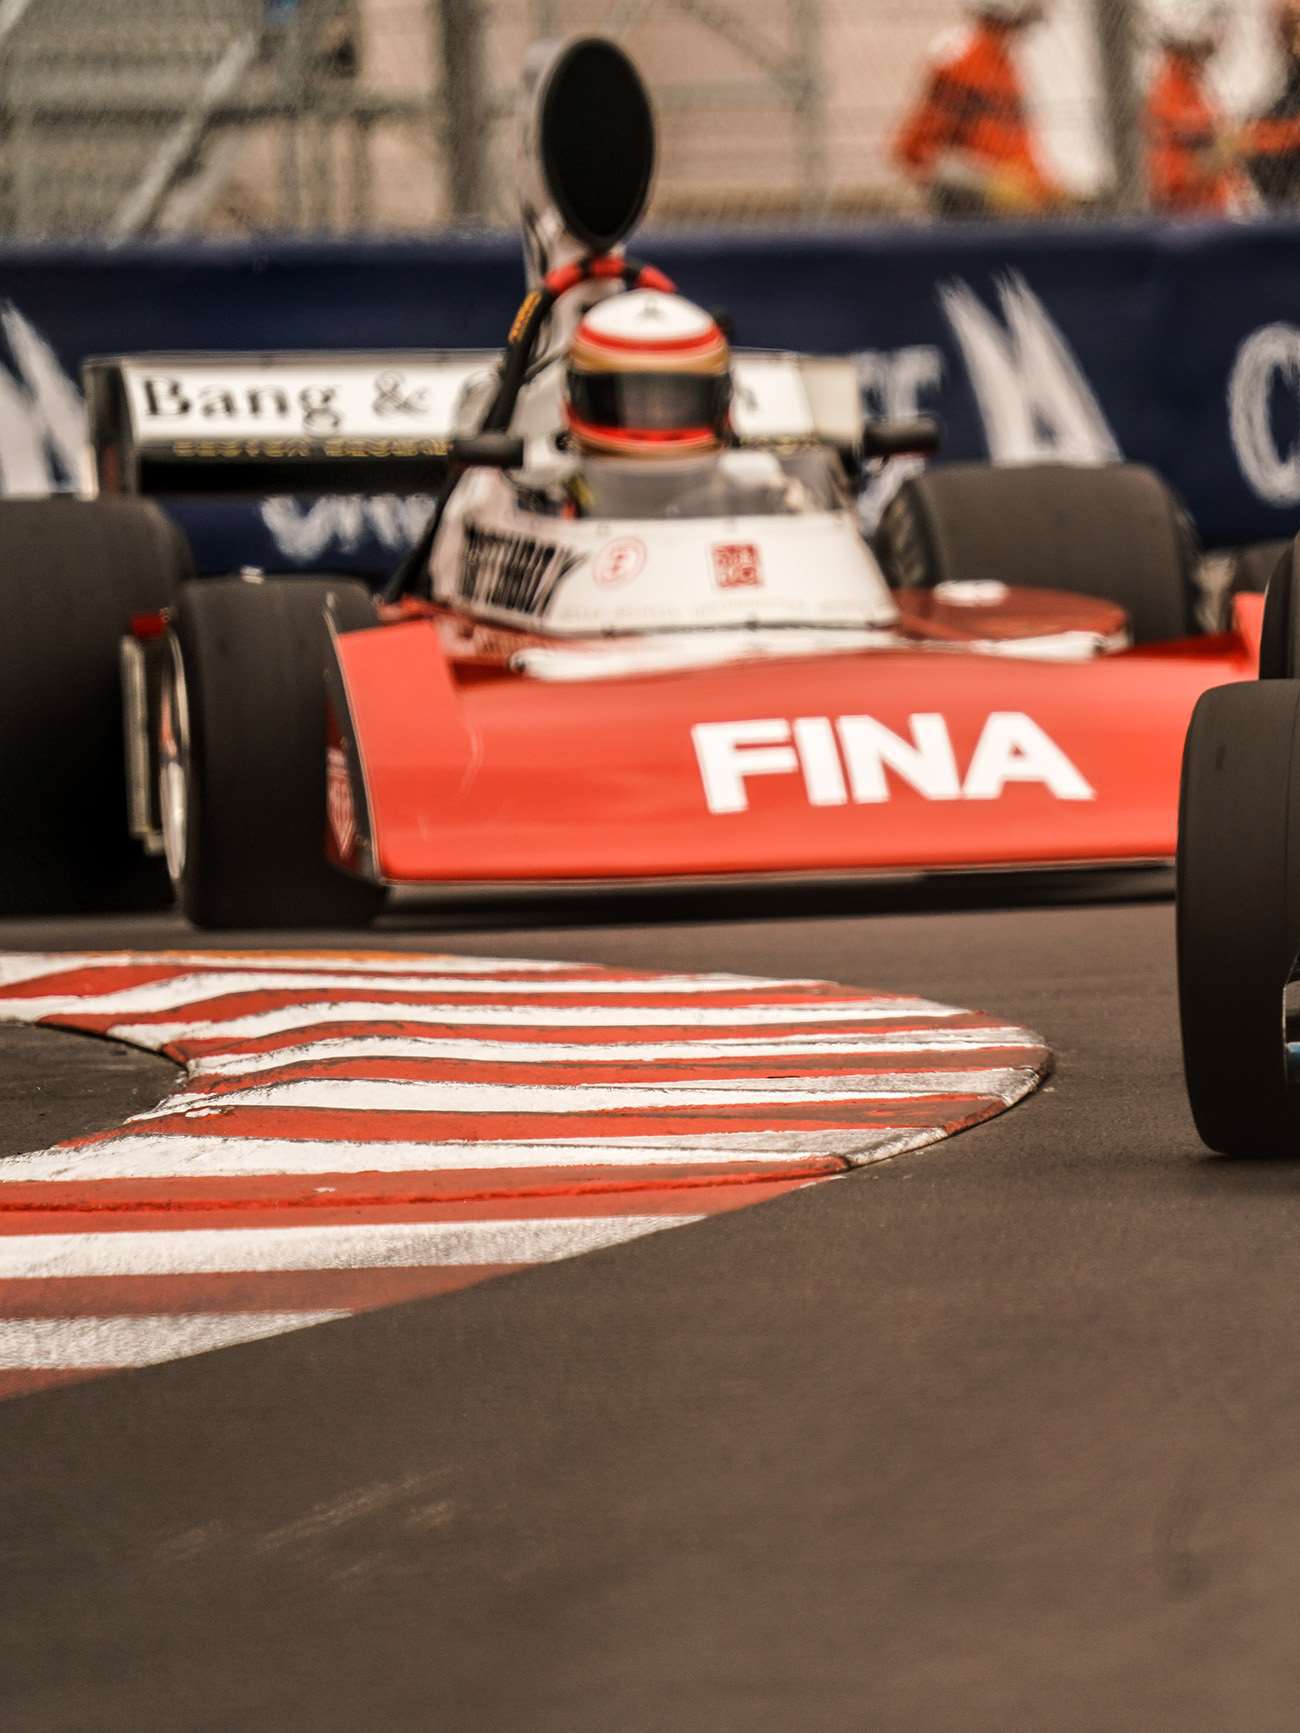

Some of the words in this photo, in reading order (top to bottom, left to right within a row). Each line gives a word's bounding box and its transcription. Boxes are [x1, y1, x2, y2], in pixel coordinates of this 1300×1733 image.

[145, 376, 341, 438] Bang
[371, 370, 432, 419] &
[690, 711, 1097, 814] FINA
